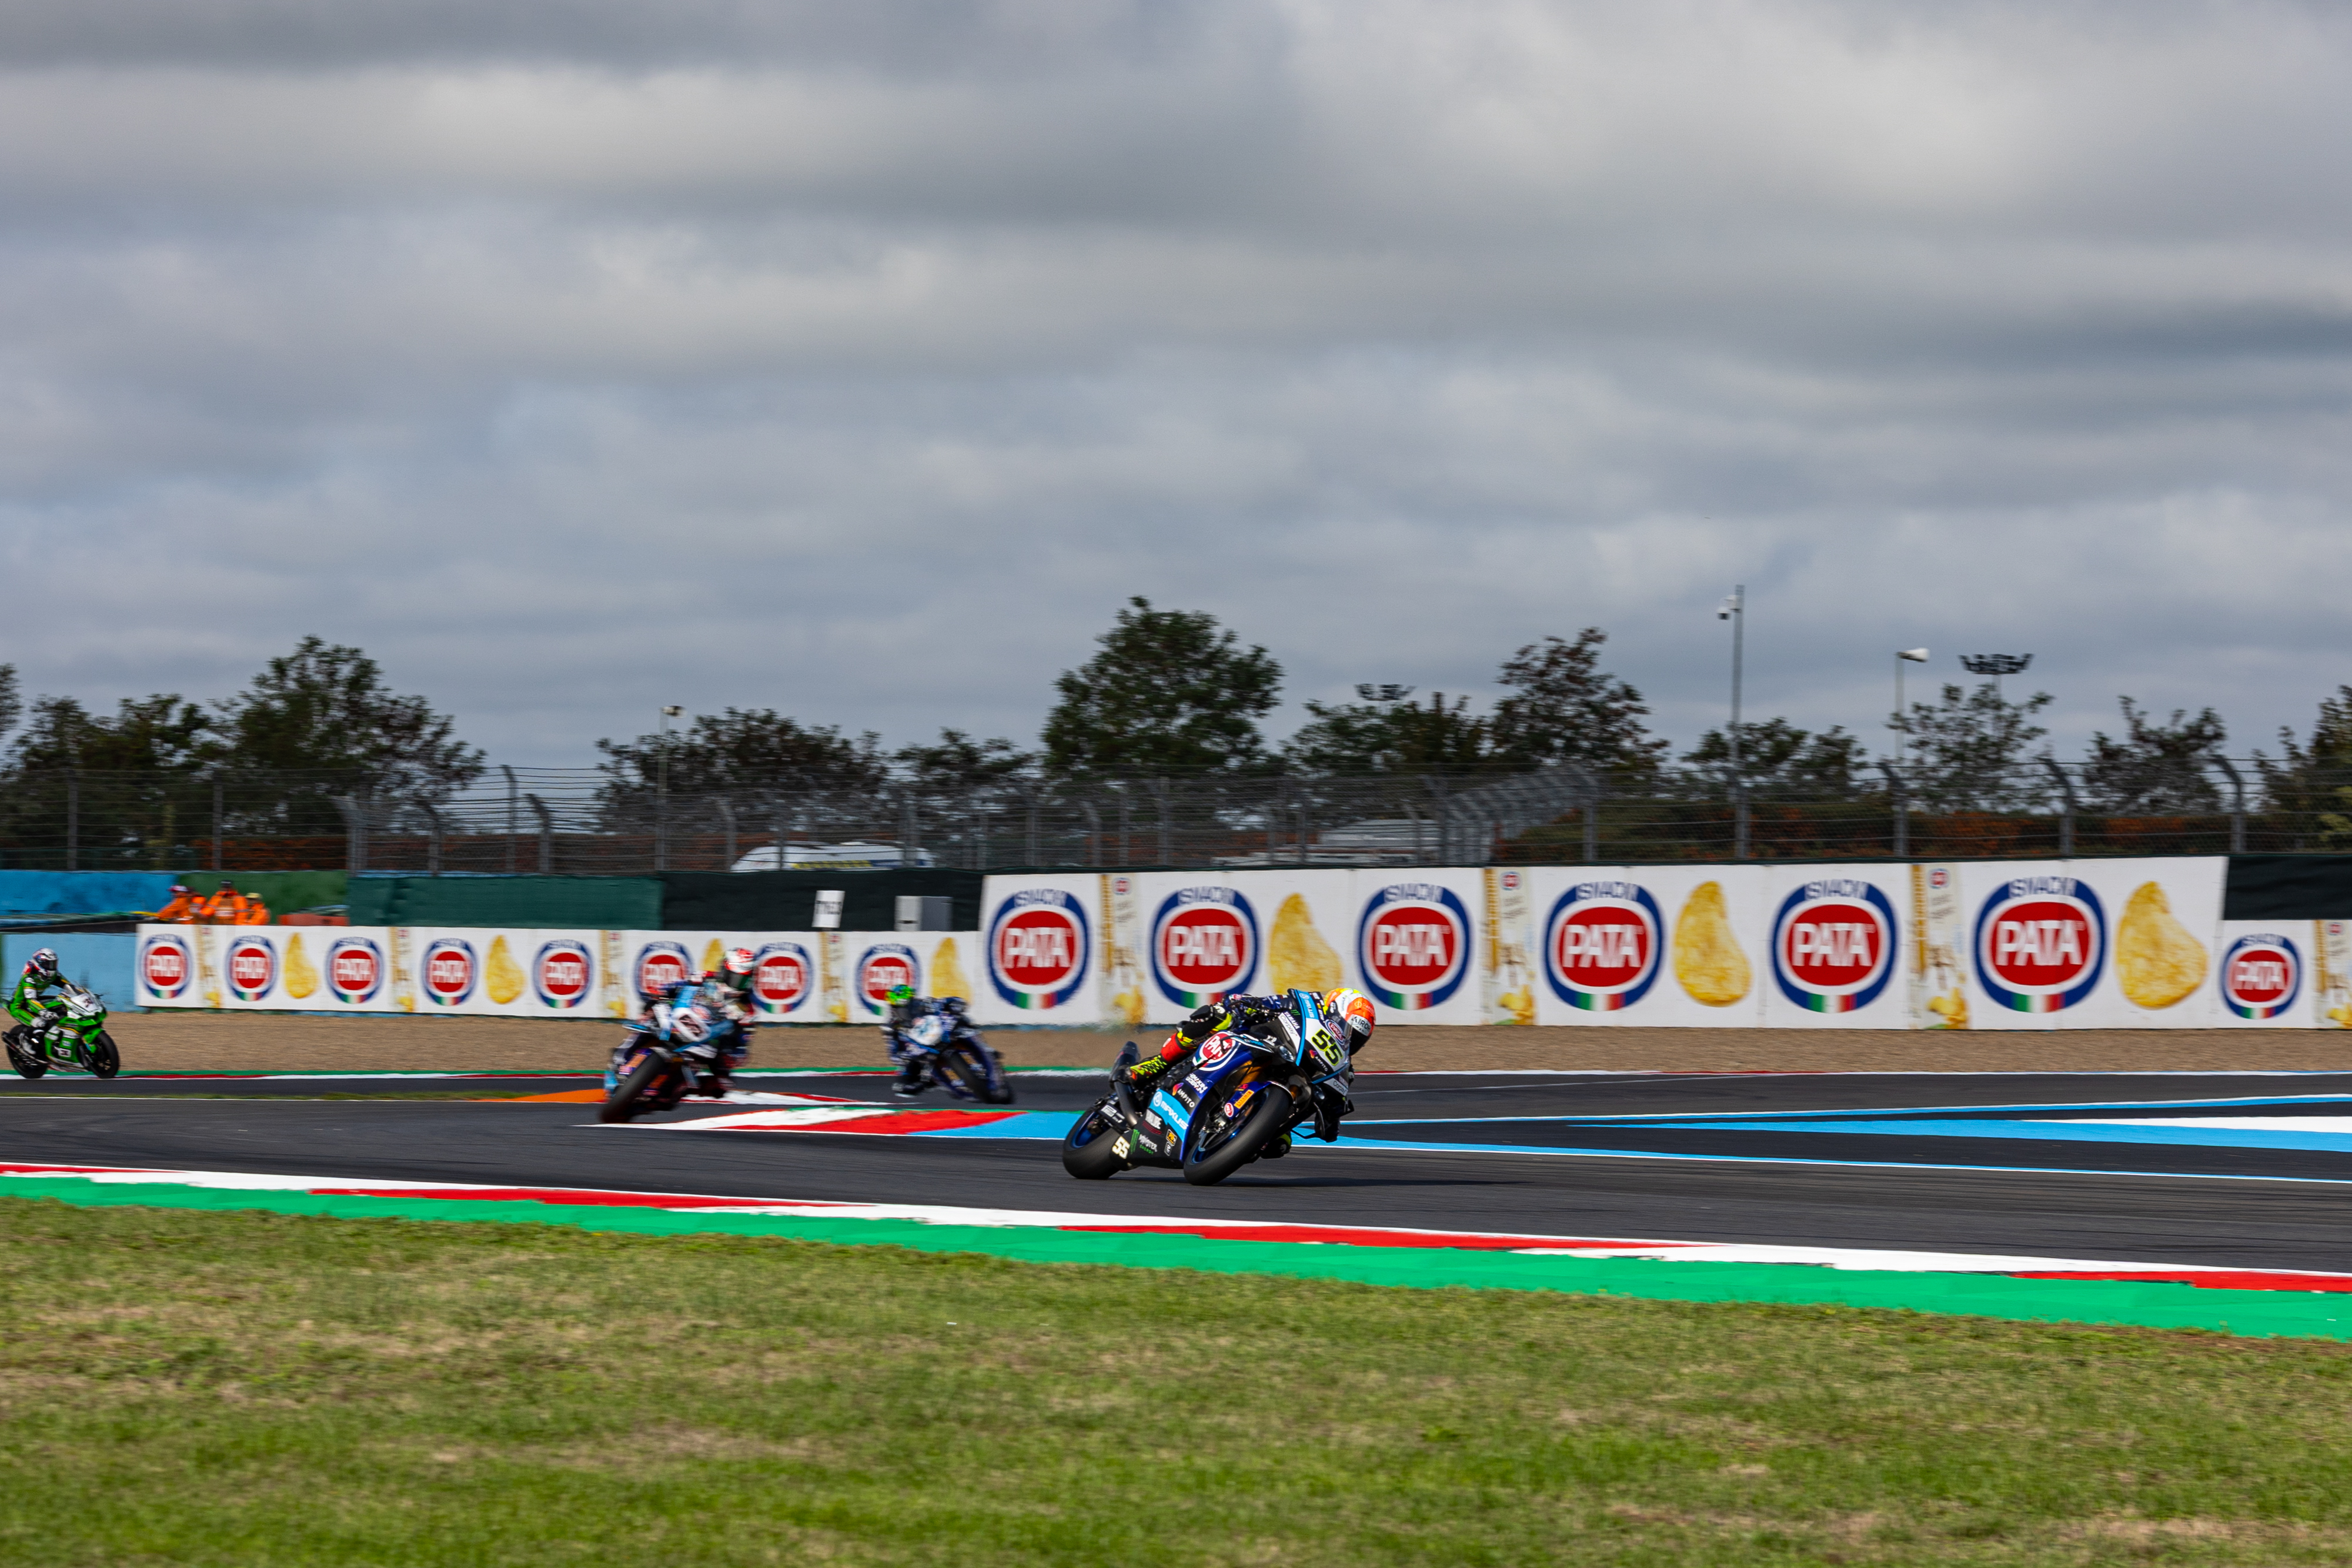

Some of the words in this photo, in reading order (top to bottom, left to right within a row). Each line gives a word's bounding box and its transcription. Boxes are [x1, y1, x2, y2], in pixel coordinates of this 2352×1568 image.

[1004, 927, 1070, 968] PATA
[1168, 925, 1240, 966] PATA
[1375, 924, 1448, 966] PATA
[1563, 925, 1641, 968] PATA
[1792, 922, 1872, 967] PATA
[1997, 921, 2083, 965] PATA
[1284, 1011, 1301, 1029] YAMAHA
[1312, 1029, 1343, 1066] 55
[1315, 1057, 1328, 1071] AMPITO
[1177, 1089, 1195, 1107] AMPITO
[1112, 1136, 1130, 1159] 55
